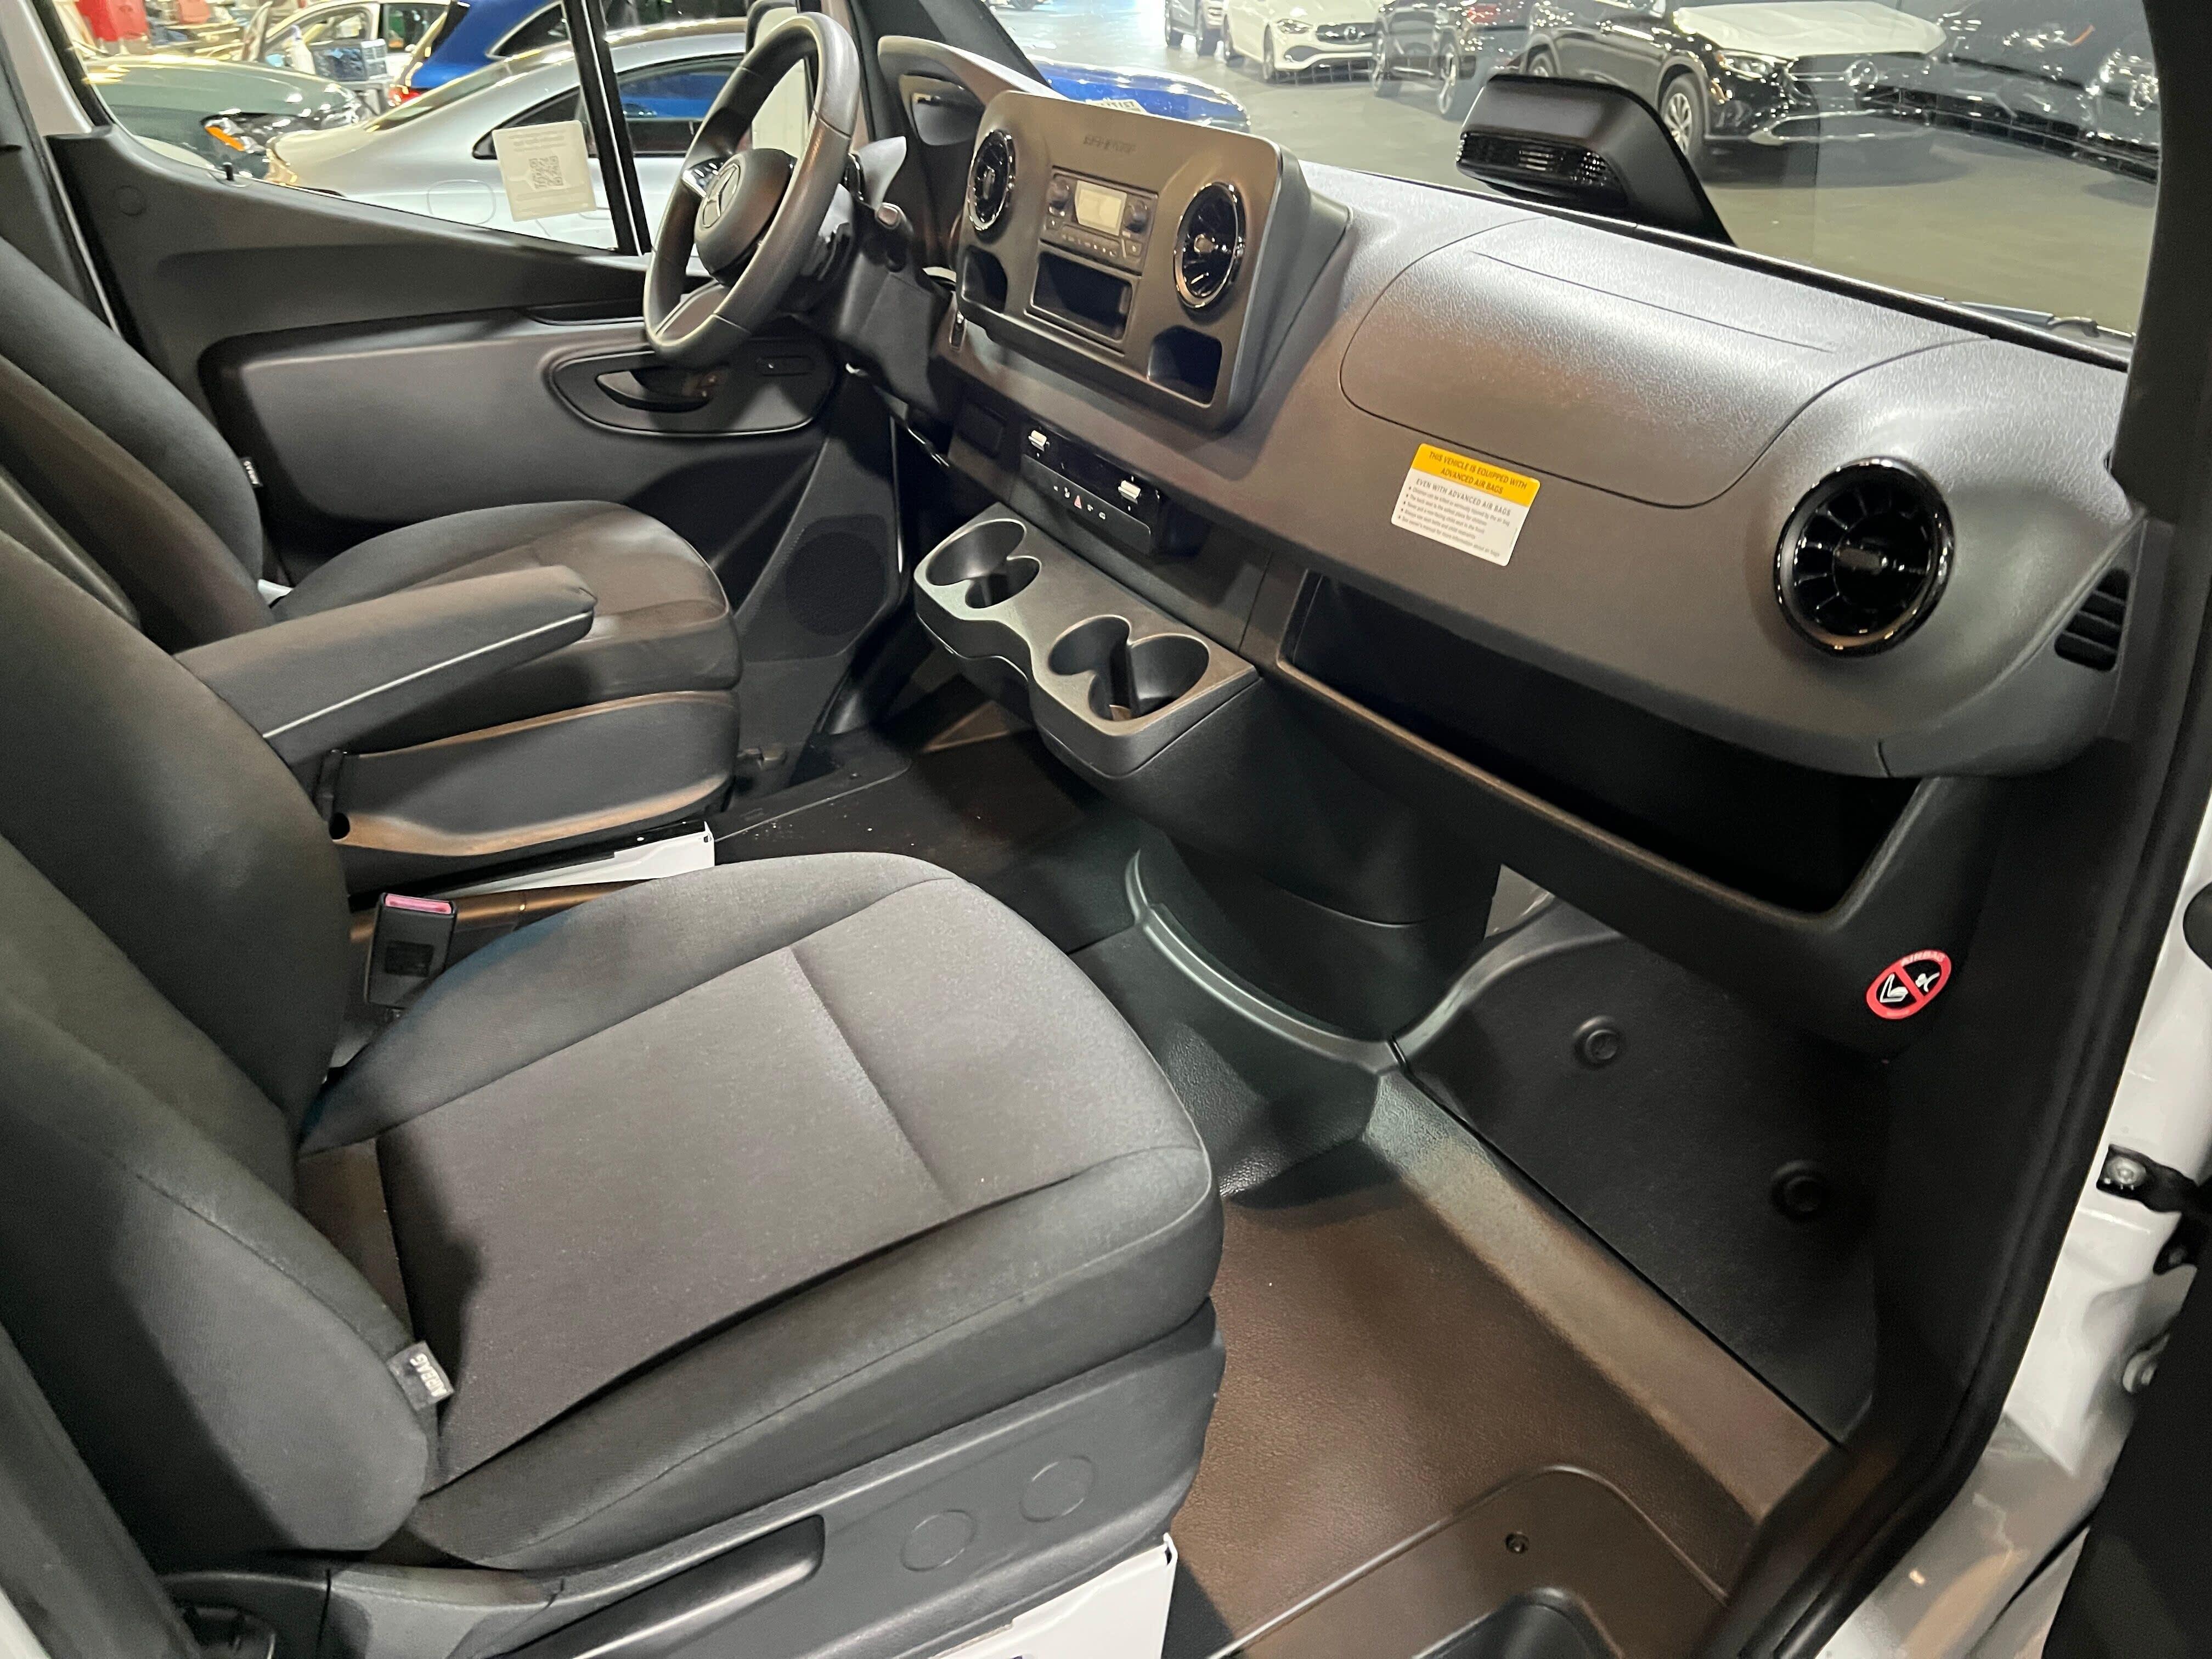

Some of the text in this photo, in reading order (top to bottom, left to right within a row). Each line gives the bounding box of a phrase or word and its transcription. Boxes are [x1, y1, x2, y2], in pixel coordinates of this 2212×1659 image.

[1429, 451, 1527, 490] THIS VEHICLE IS EQUIPPED WITH
[1440, 467, 1504, 494] ADVANCED AIR BAGS
[1416, 478, 1511, 516] EVEN WITH ADVANCED AIR BAGS
[409, 1353, 448, 1397] AIRBAG
